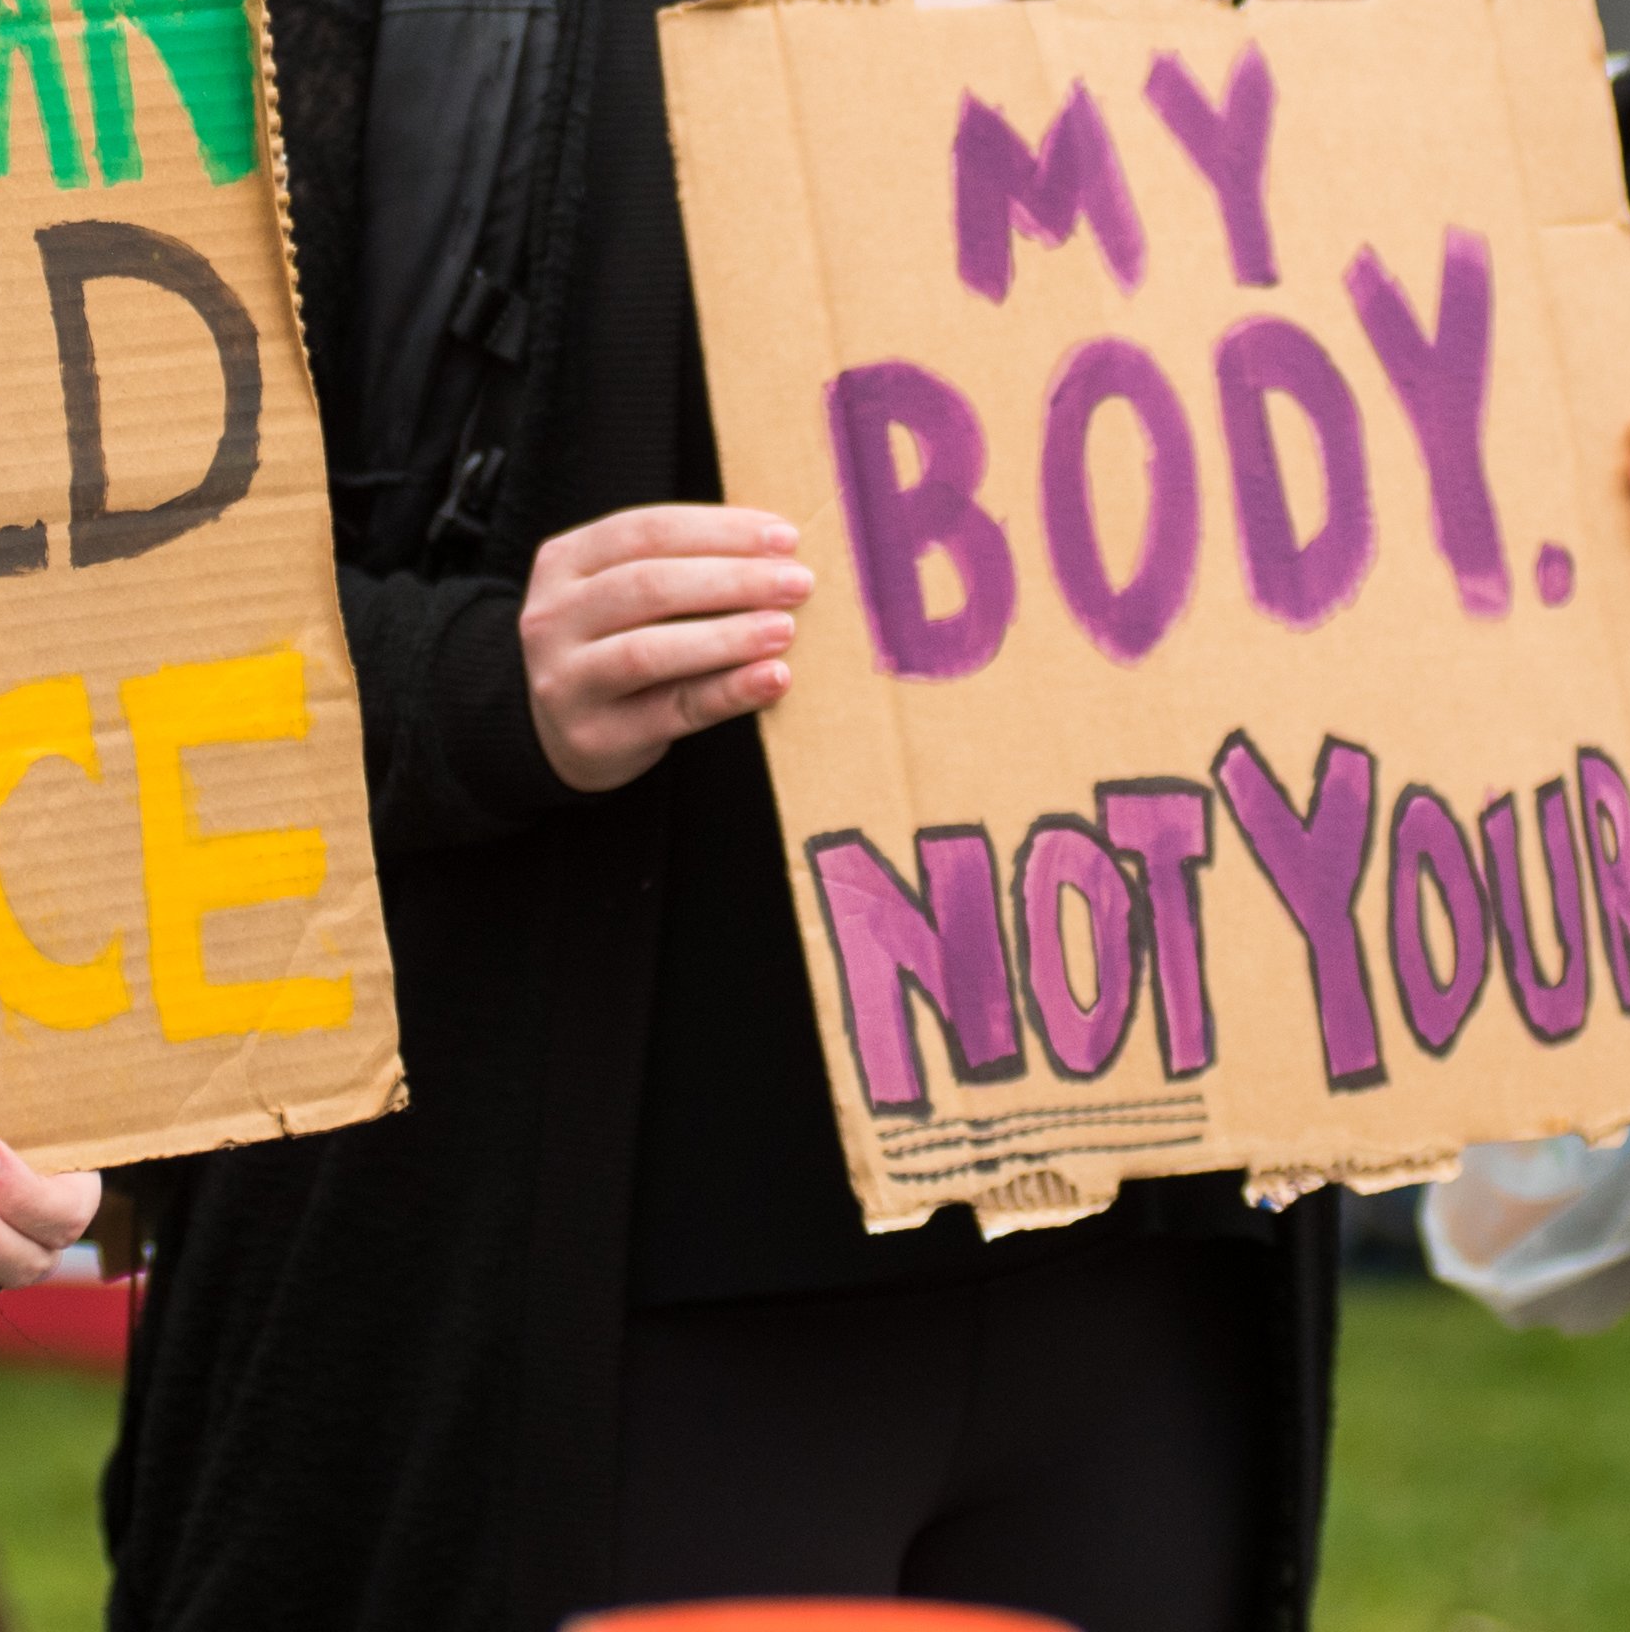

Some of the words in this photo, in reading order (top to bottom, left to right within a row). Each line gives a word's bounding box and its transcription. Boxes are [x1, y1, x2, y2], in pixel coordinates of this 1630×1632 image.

[952, 39, 1278, 304] MY
[825, 224, 1575, 681] BODY.
[805, 777, 1215, 1118] NOT
